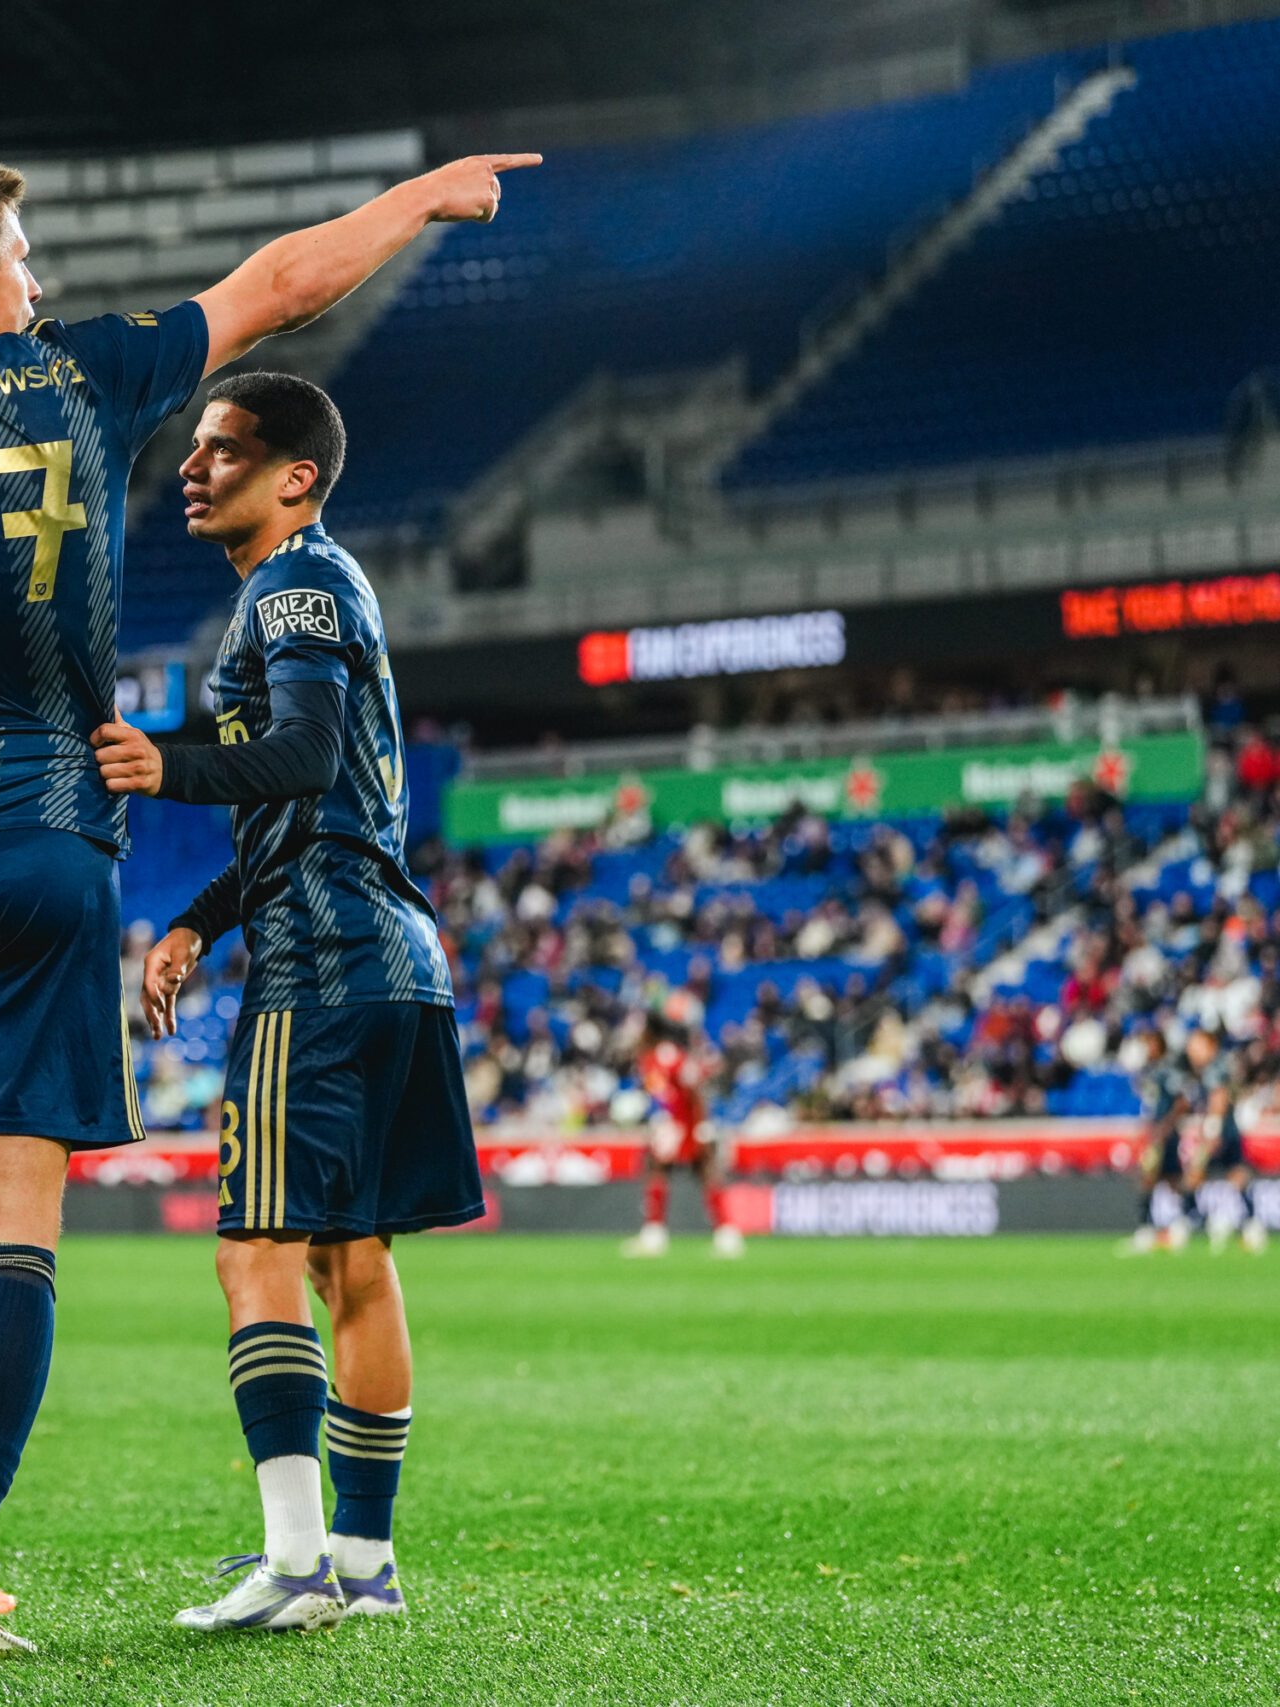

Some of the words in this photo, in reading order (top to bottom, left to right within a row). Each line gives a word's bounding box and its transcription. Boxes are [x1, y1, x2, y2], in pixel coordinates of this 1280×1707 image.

[262, 602, 273, 624] MLS
[273, 594, 329, 620] NEXT
[284, 613, 334, 634] PRO
